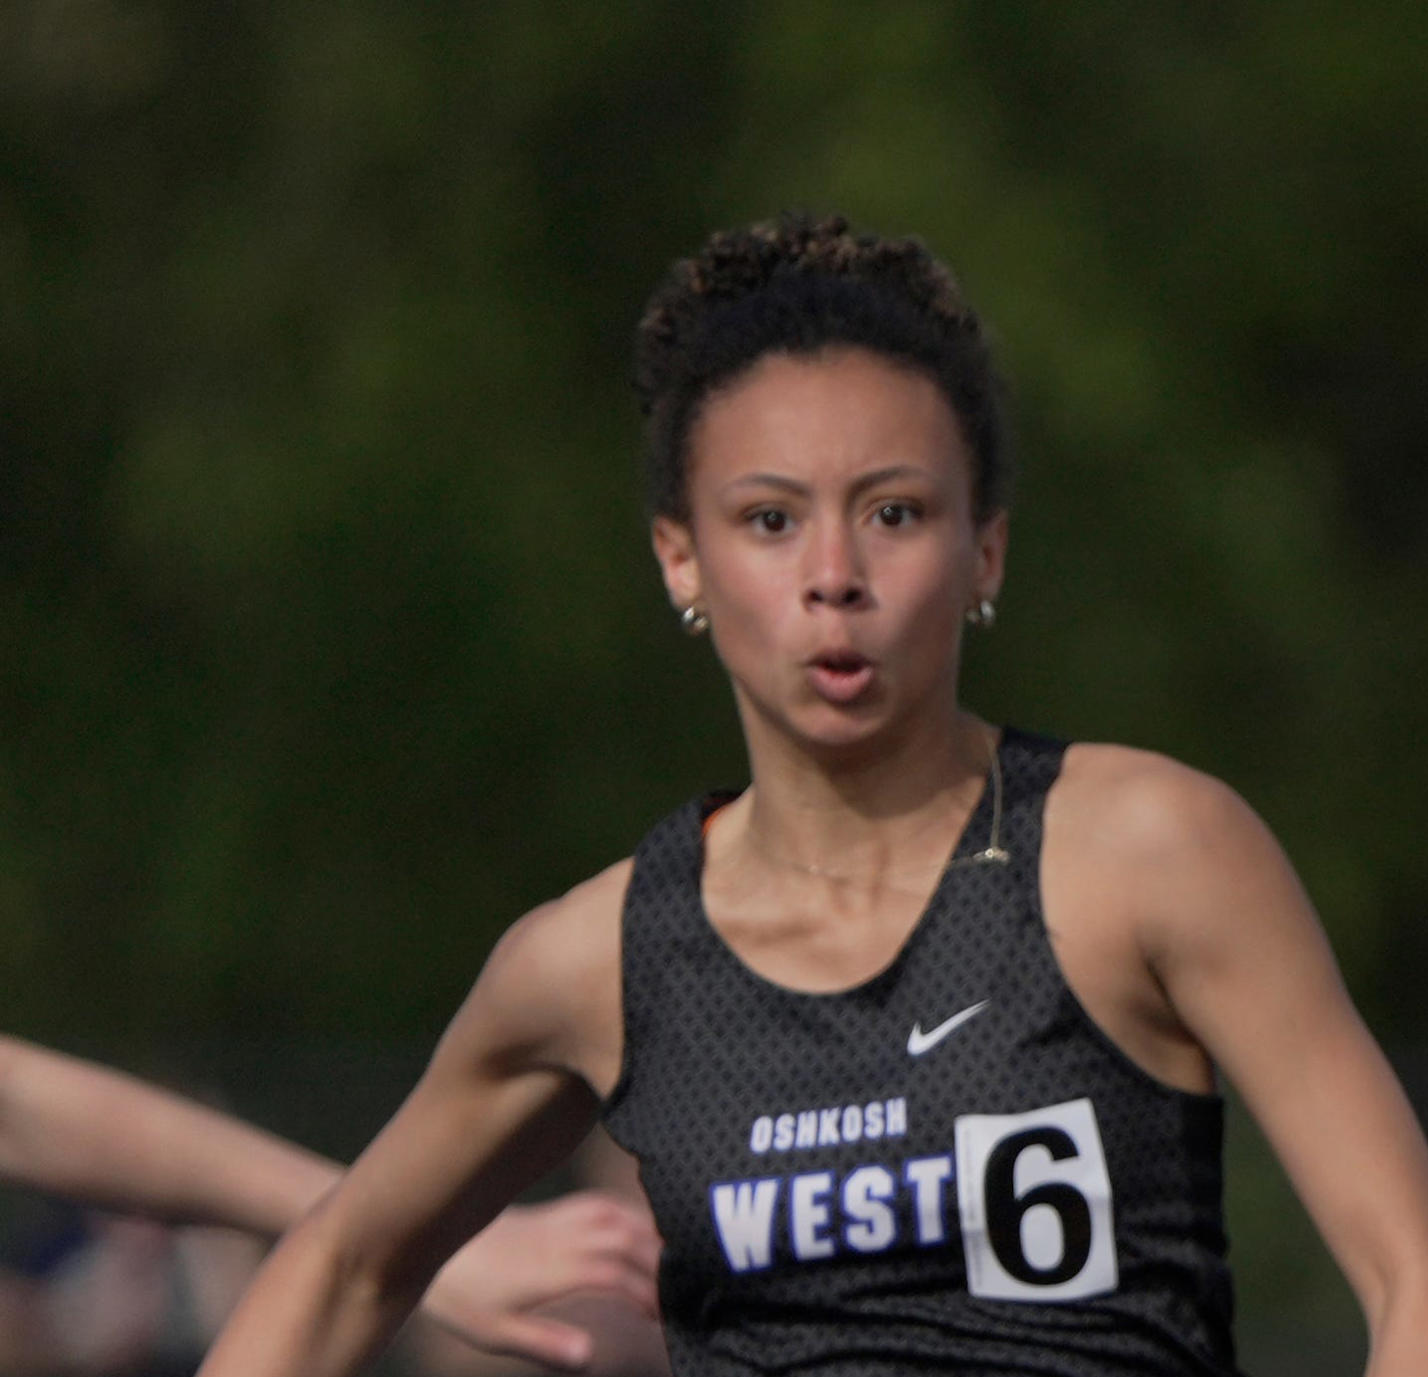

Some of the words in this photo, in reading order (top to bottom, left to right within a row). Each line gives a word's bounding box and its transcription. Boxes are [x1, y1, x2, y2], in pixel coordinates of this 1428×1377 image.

[750, 1099, 906, 1154] OSHKOSH
[711, 1154, 953, 1273] WEST
[984, 1126, 1091, 1284] 6
